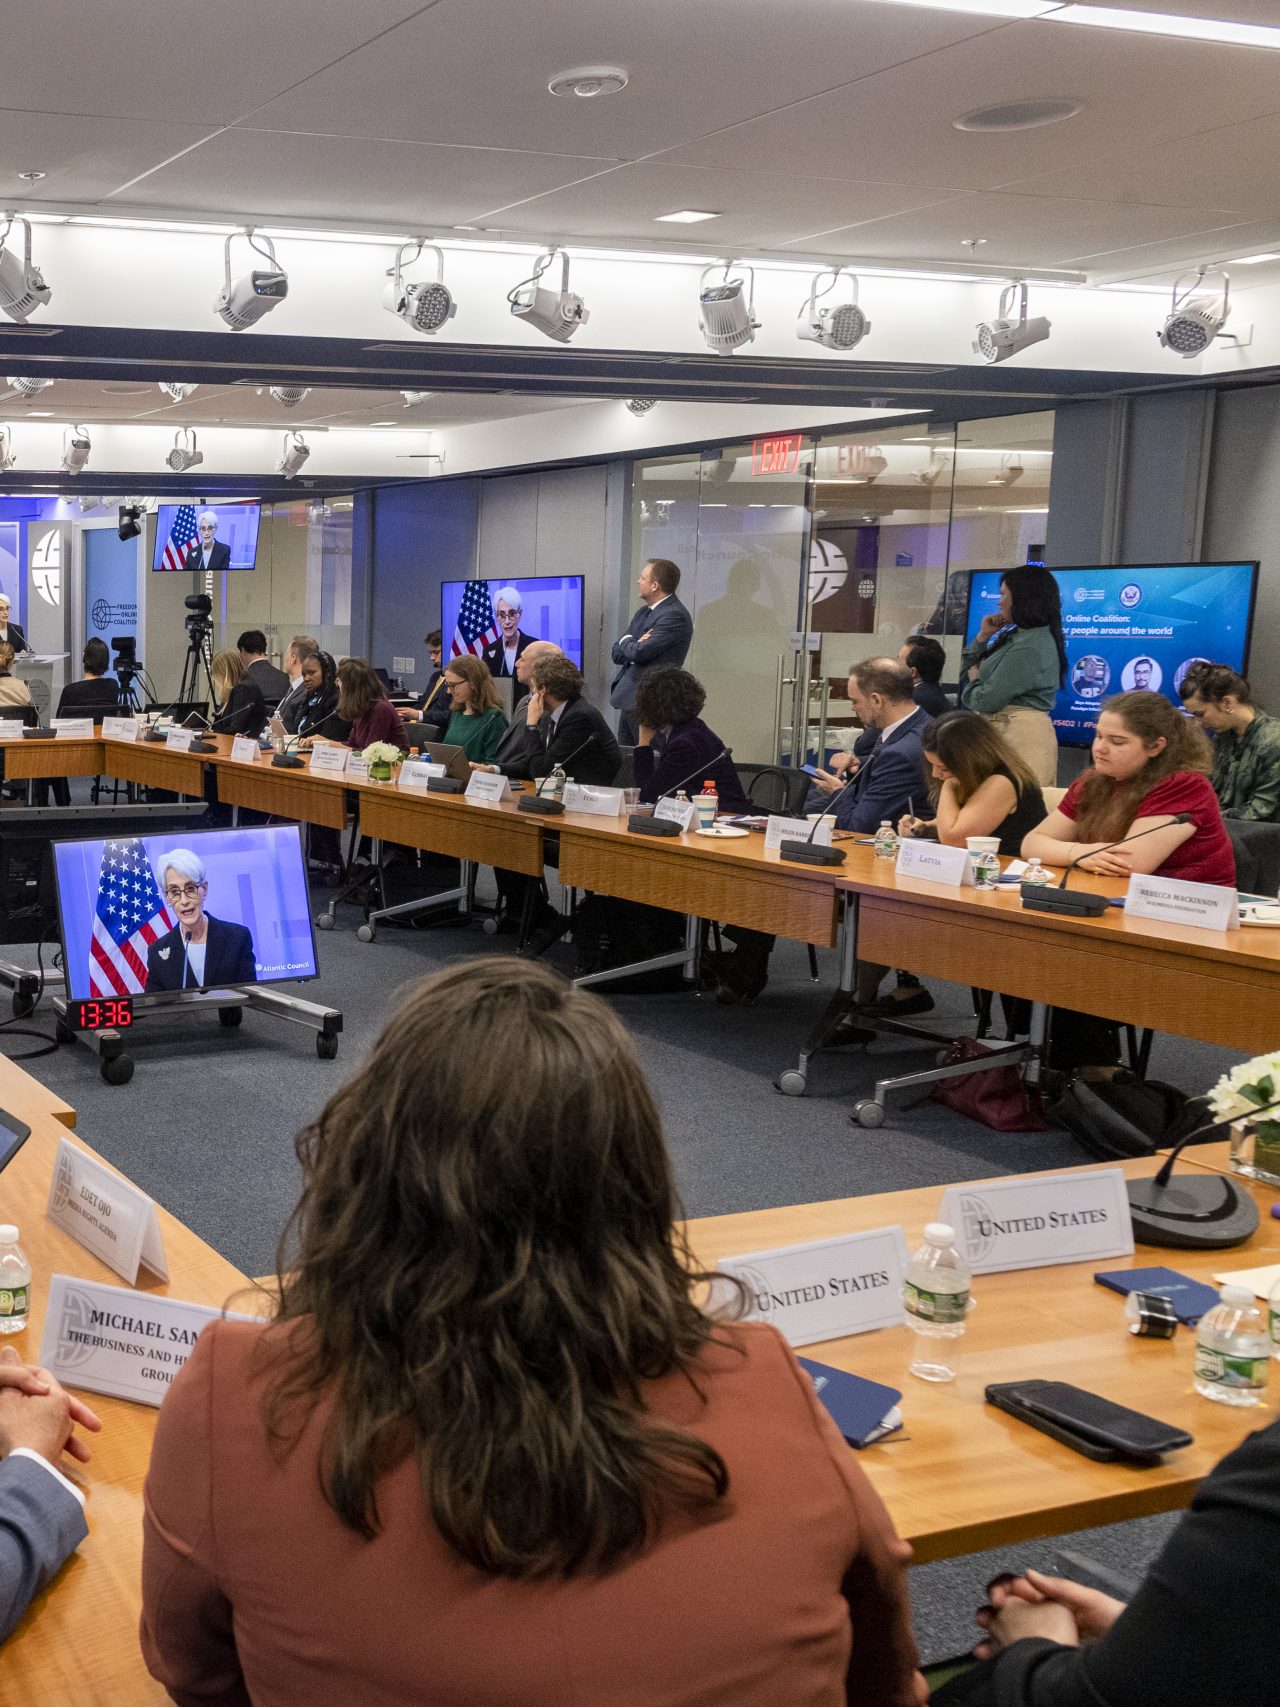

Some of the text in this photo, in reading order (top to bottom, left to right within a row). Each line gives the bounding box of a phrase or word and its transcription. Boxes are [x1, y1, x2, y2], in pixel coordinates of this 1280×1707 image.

[761, 440, 793, 472] EXIT
[1071, 627, 1099, 635] people
[1100, 627, 1130, 635] around
[1132, 627, 1146, 635] the
[1148, 627, 1173, 635] world
[1140, 889, 1171, 899] REBECCA
[263, 962, 310, 972] Atlantic Council
[80, 1001, 131, 1028] 13:36
[80, 1186, 111, 1217] EDET OJO
[977, 1209, 1108, 1237] UNITED STATES
[756, 1270, 890, 1312] UNITED STATES
[90, 1310, 165, 1339] MICHAEL
[68, 1330, 89, 1345] THE
[92, 1337, 146, 1357] BUSINESS
[147, 1349, 171, 1363] AND
[141, 1367, 176, 1384] GROU
